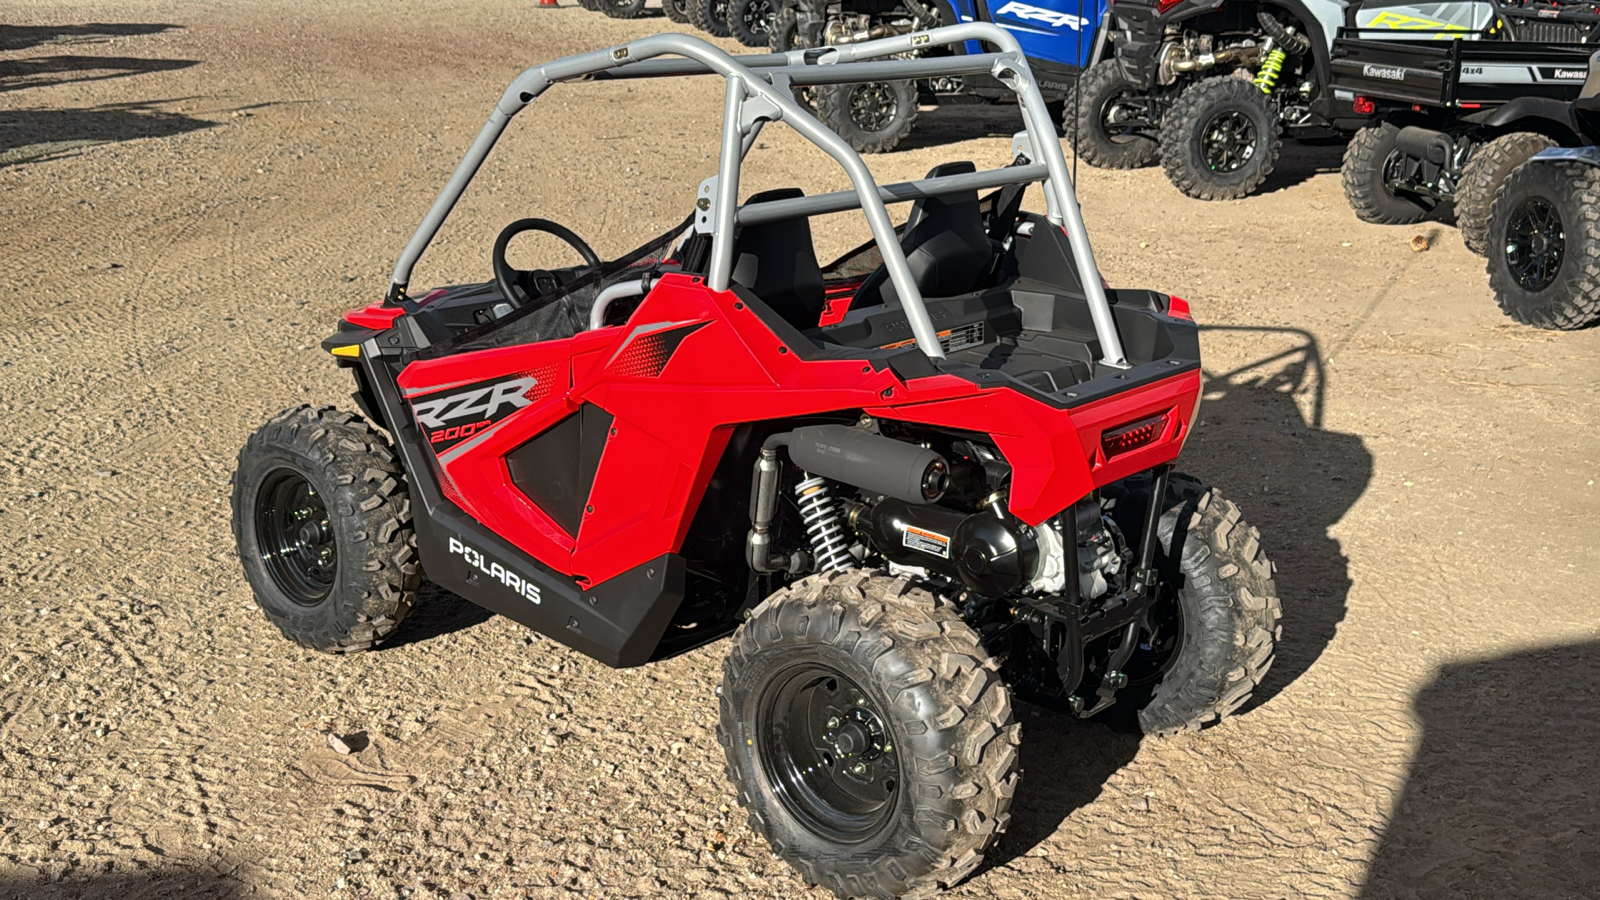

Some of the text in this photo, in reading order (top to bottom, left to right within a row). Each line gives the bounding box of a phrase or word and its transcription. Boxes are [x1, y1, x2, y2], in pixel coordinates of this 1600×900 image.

[996, 1, 1089, 31] RZR
[1366, 11, 1471, 40] RZR
[1038, 80, 1068, 91] LARIS
[1363, 63, 1406, 81] Kawasaki
[1462, 67, 1483, 75] 4x4
[412, 376, 538, 429] RZR
[449, 537, 542, 605] POLARIS
